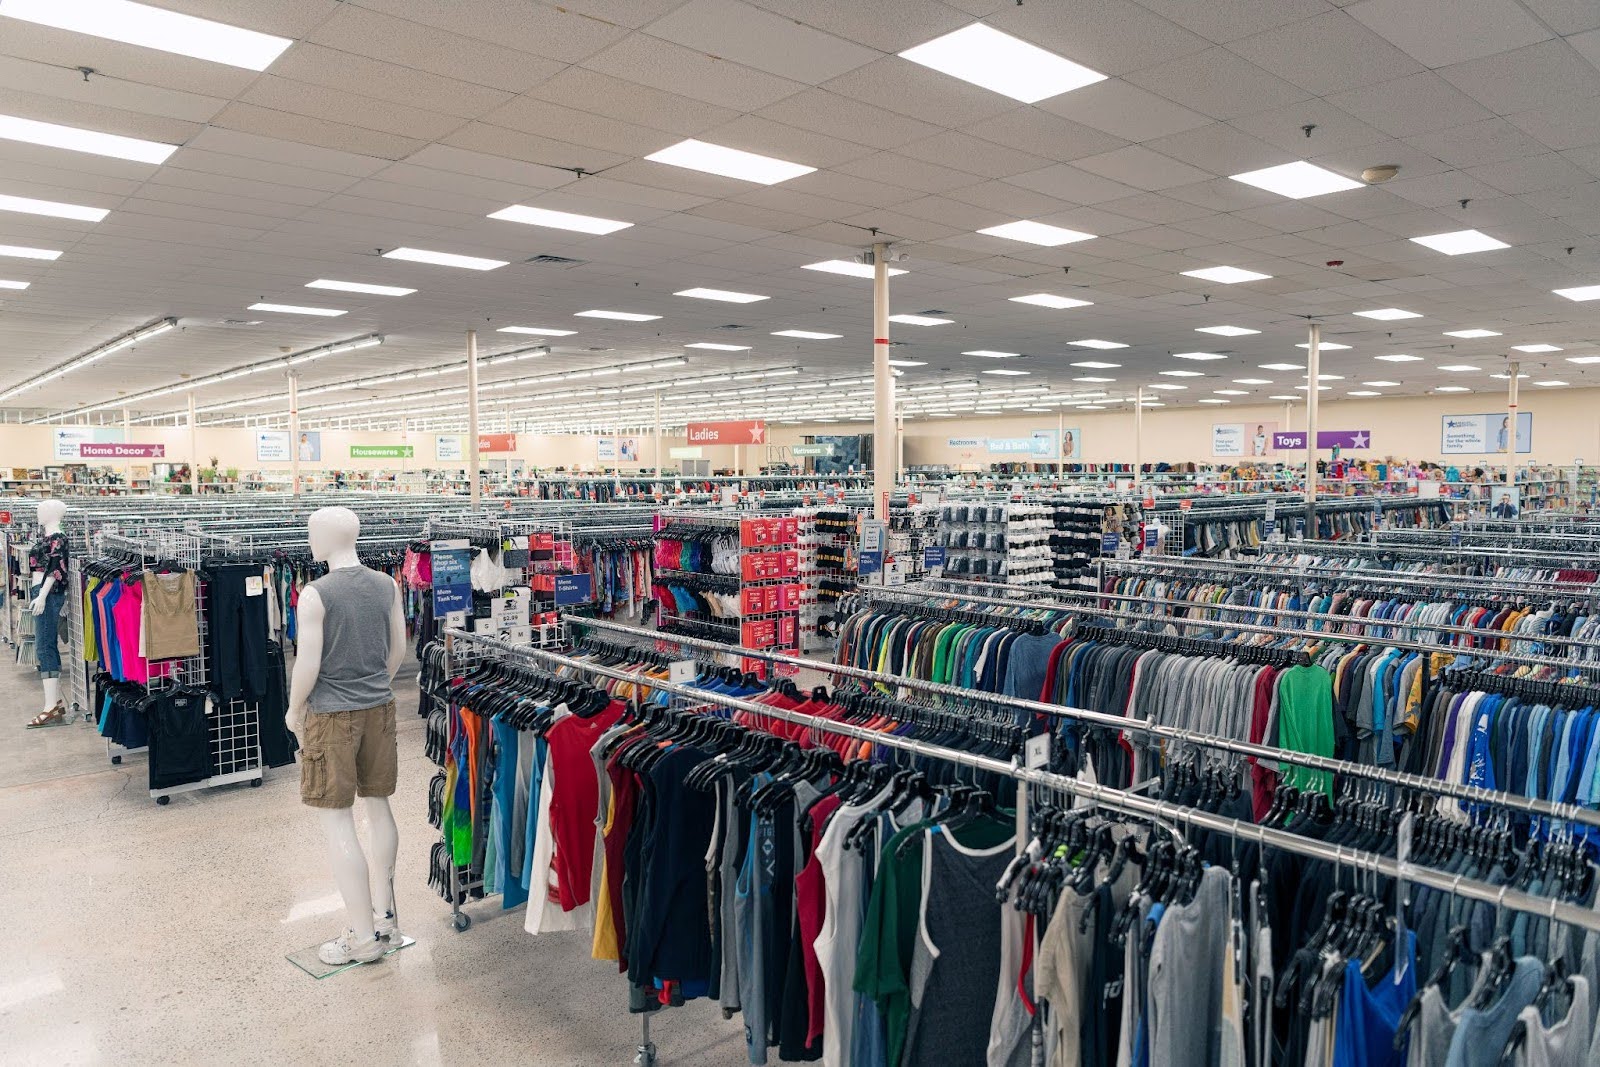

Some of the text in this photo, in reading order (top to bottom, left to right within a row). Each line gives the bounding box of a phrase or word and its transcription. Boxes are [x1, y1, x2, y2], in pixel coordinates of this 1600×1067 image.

[690, 429, 719, 441] Ladies
[990, 441, 1030, 450] Bed & Bath
[1276, 435, 1302, 448] Toys
[83, 446, 113, 455] Home
[115, 446, 145, 455] Decor
[352, 448, 398, 456] Housewares
